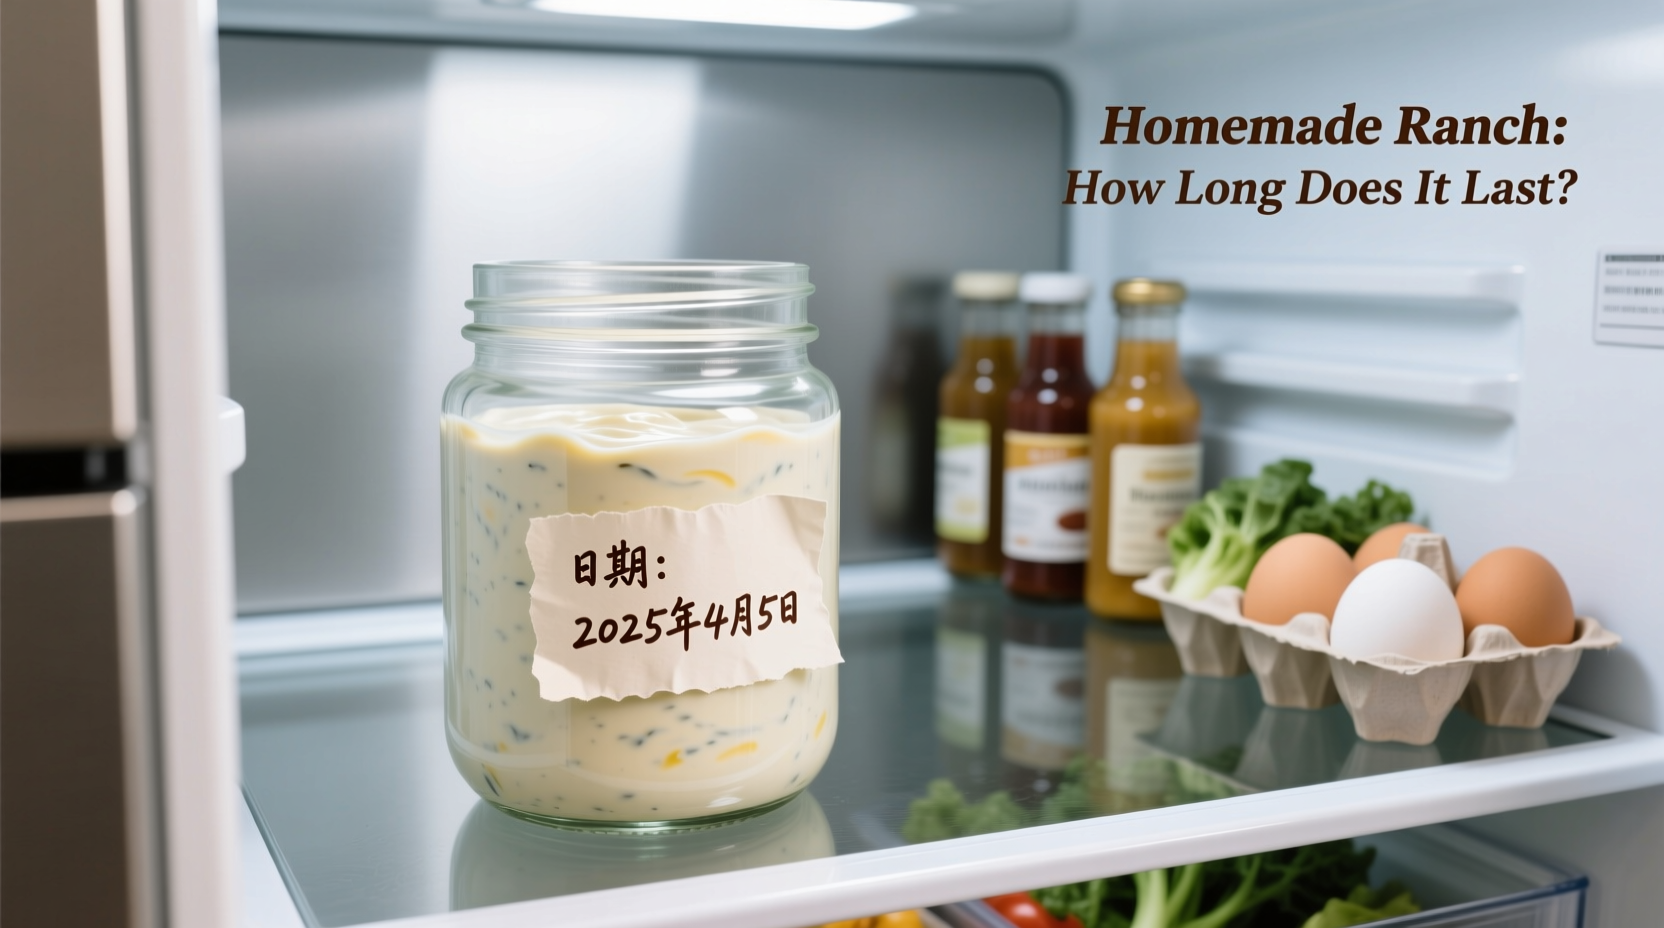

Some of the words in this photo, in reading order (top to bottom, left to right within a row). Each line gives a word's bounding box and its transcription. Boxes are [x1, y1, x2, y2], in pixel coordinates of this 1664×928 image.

[574, 539, 667, 589] 日期：
[572, 590, 798, 652] 2025年4月5日
